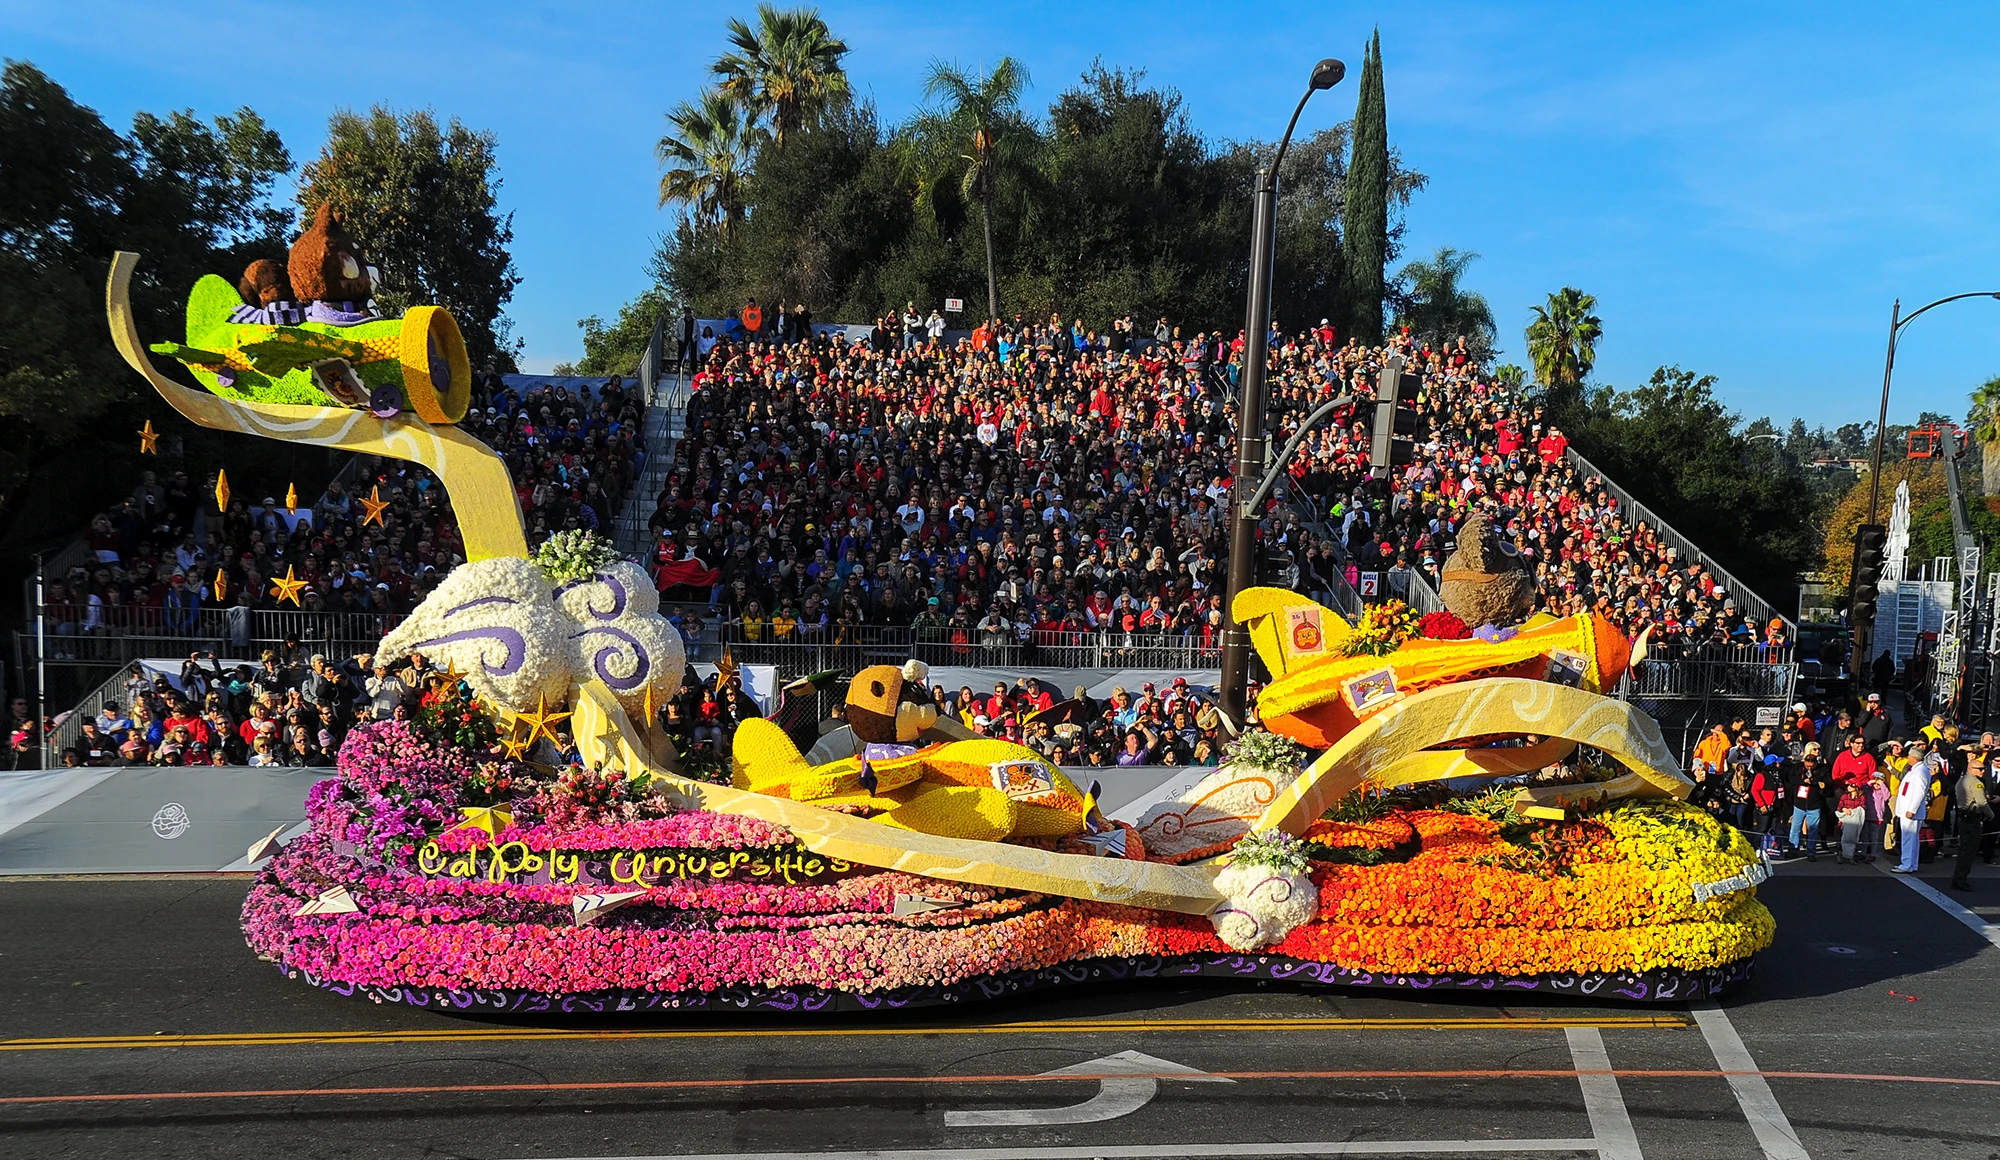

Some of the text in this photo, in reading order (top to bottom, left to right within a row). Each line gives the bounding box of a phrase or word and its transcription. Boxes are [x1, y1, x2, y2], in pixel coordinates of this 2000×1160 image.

[1364, 580, 1375, 595] 2
[418, 841, 851, 889] Cal Poly Universities
